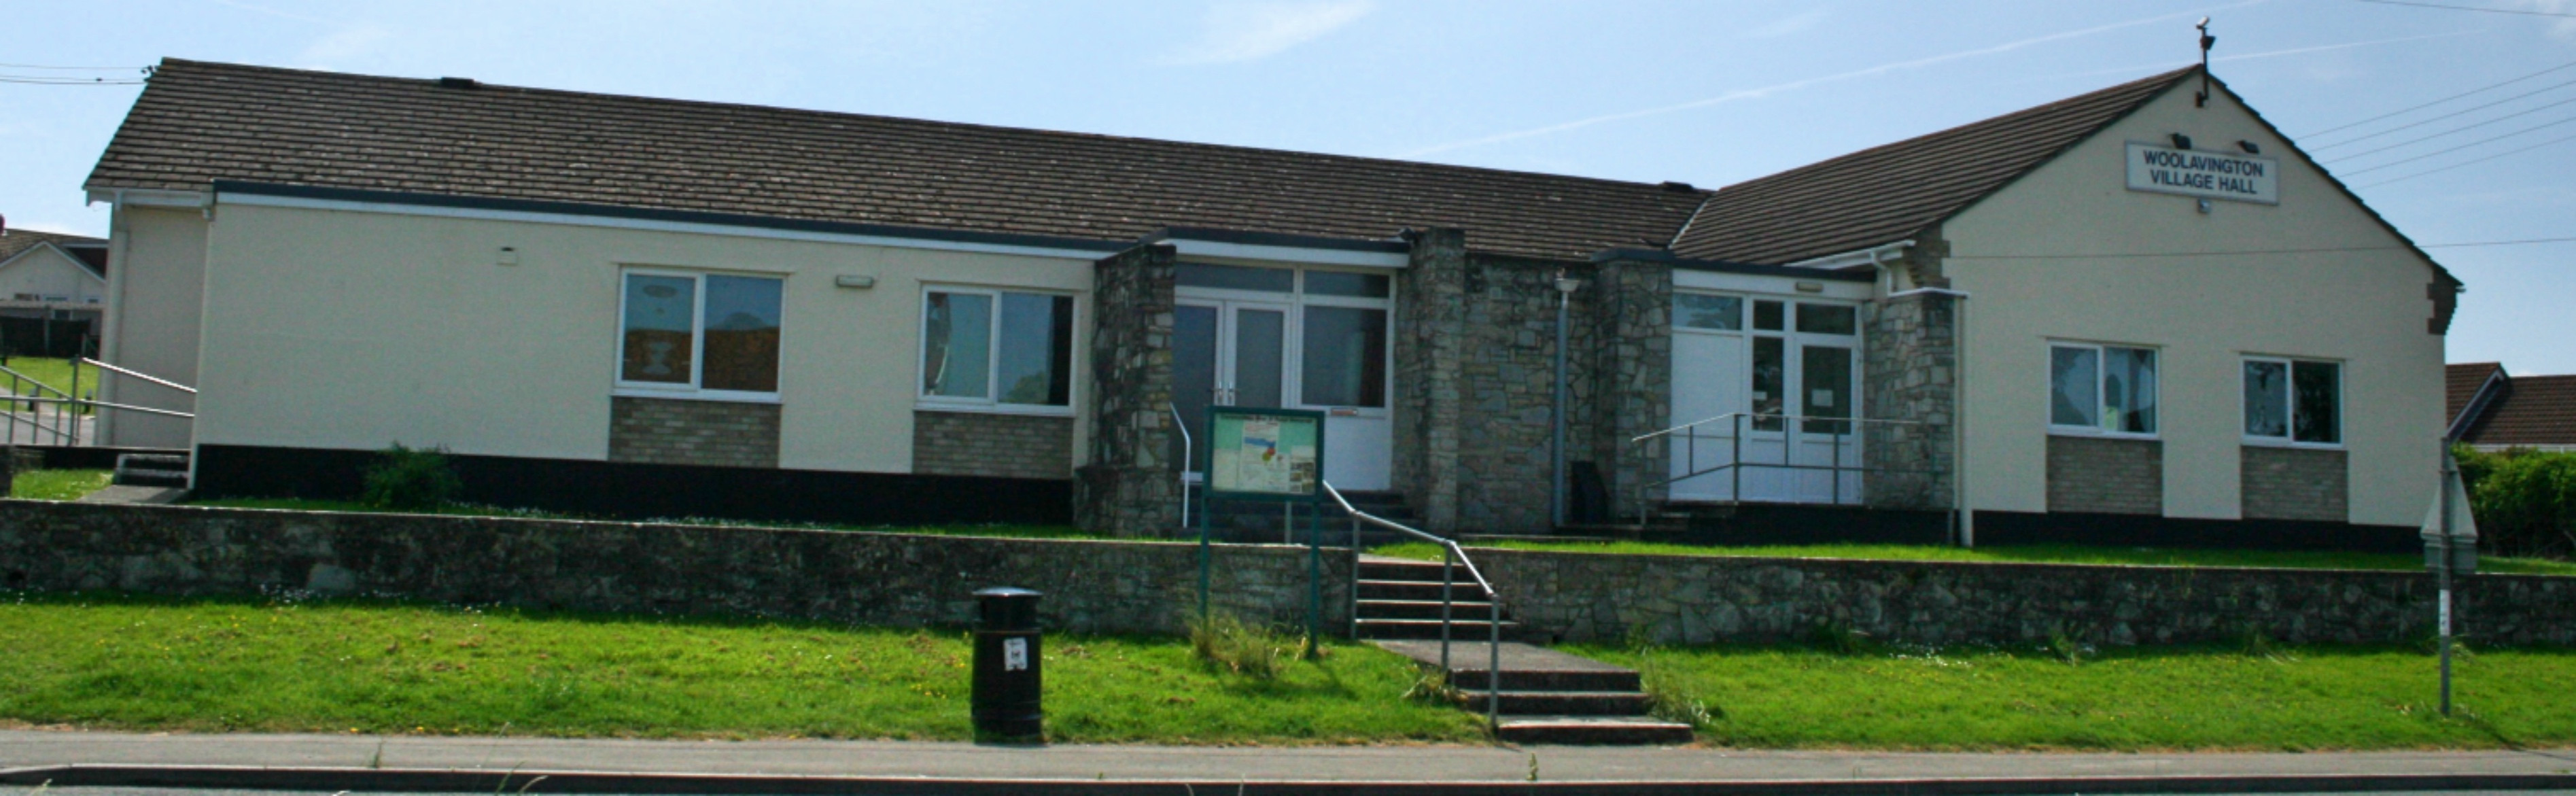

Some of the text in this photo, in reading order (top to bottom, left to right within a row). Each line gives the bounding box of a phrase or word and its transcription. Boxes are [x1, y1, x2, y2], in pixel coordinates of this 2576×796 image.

[2144, 150, 2262, 177] WOOLAVINGTON
[2151, 169, 2257, 194] VILLAGE HALL
